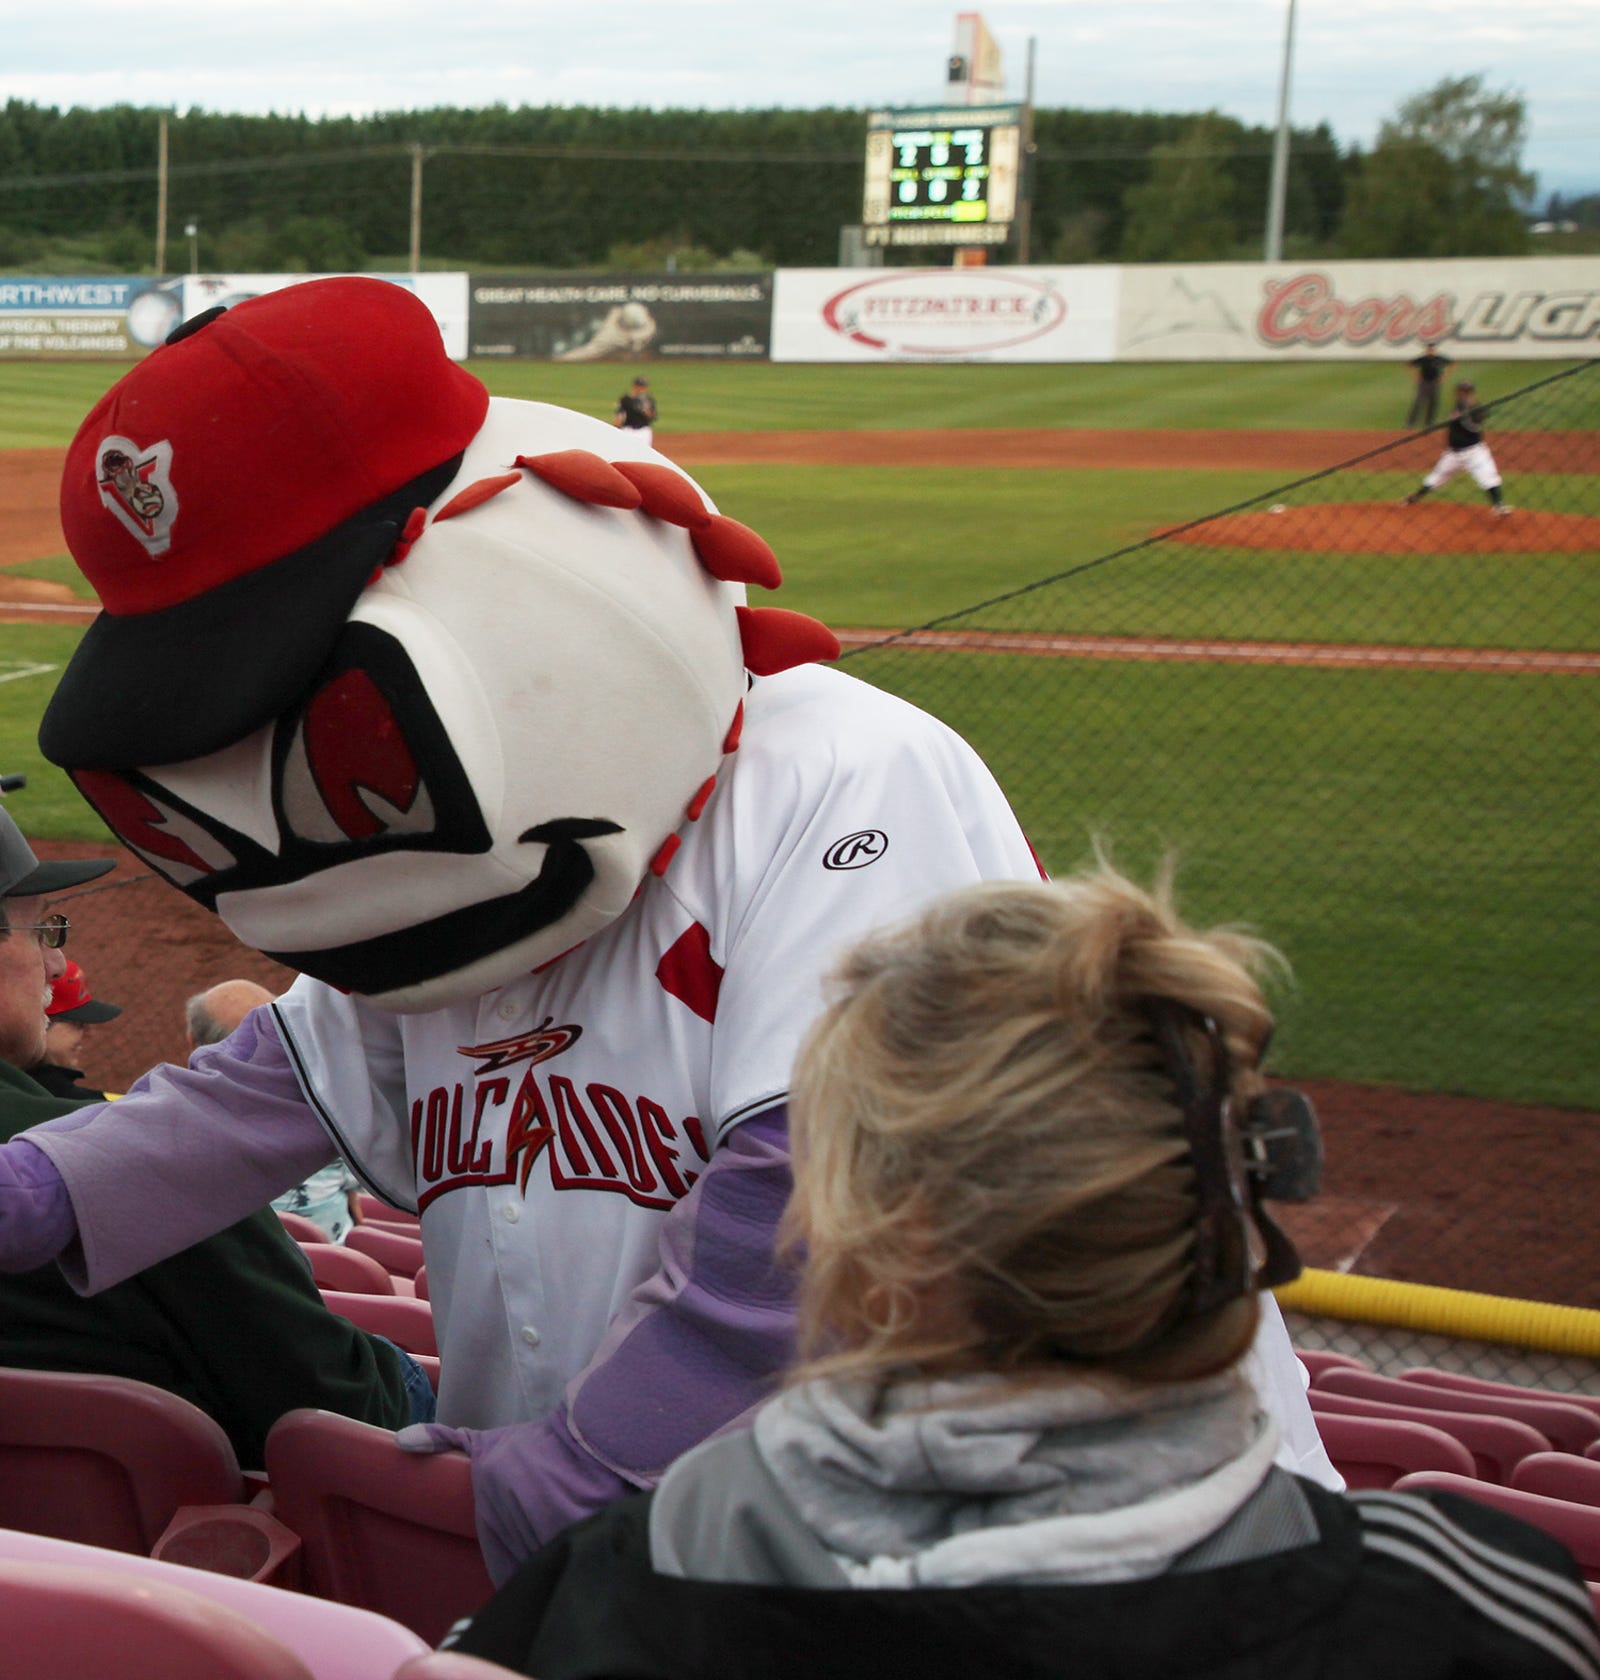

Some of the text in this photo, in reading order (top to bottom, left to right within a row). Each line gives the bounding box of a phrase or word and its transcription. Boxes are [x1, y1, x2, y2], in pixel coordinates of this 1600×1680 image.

[863, 296, 1032, 318] FITZPATRICK
[1256, 272, 1457, 347] Coors
[55, 319, 120, 334] THERAPY
[14, 335, 43, 351] THE
[45, 335, 128, 352] VOLCANOES
